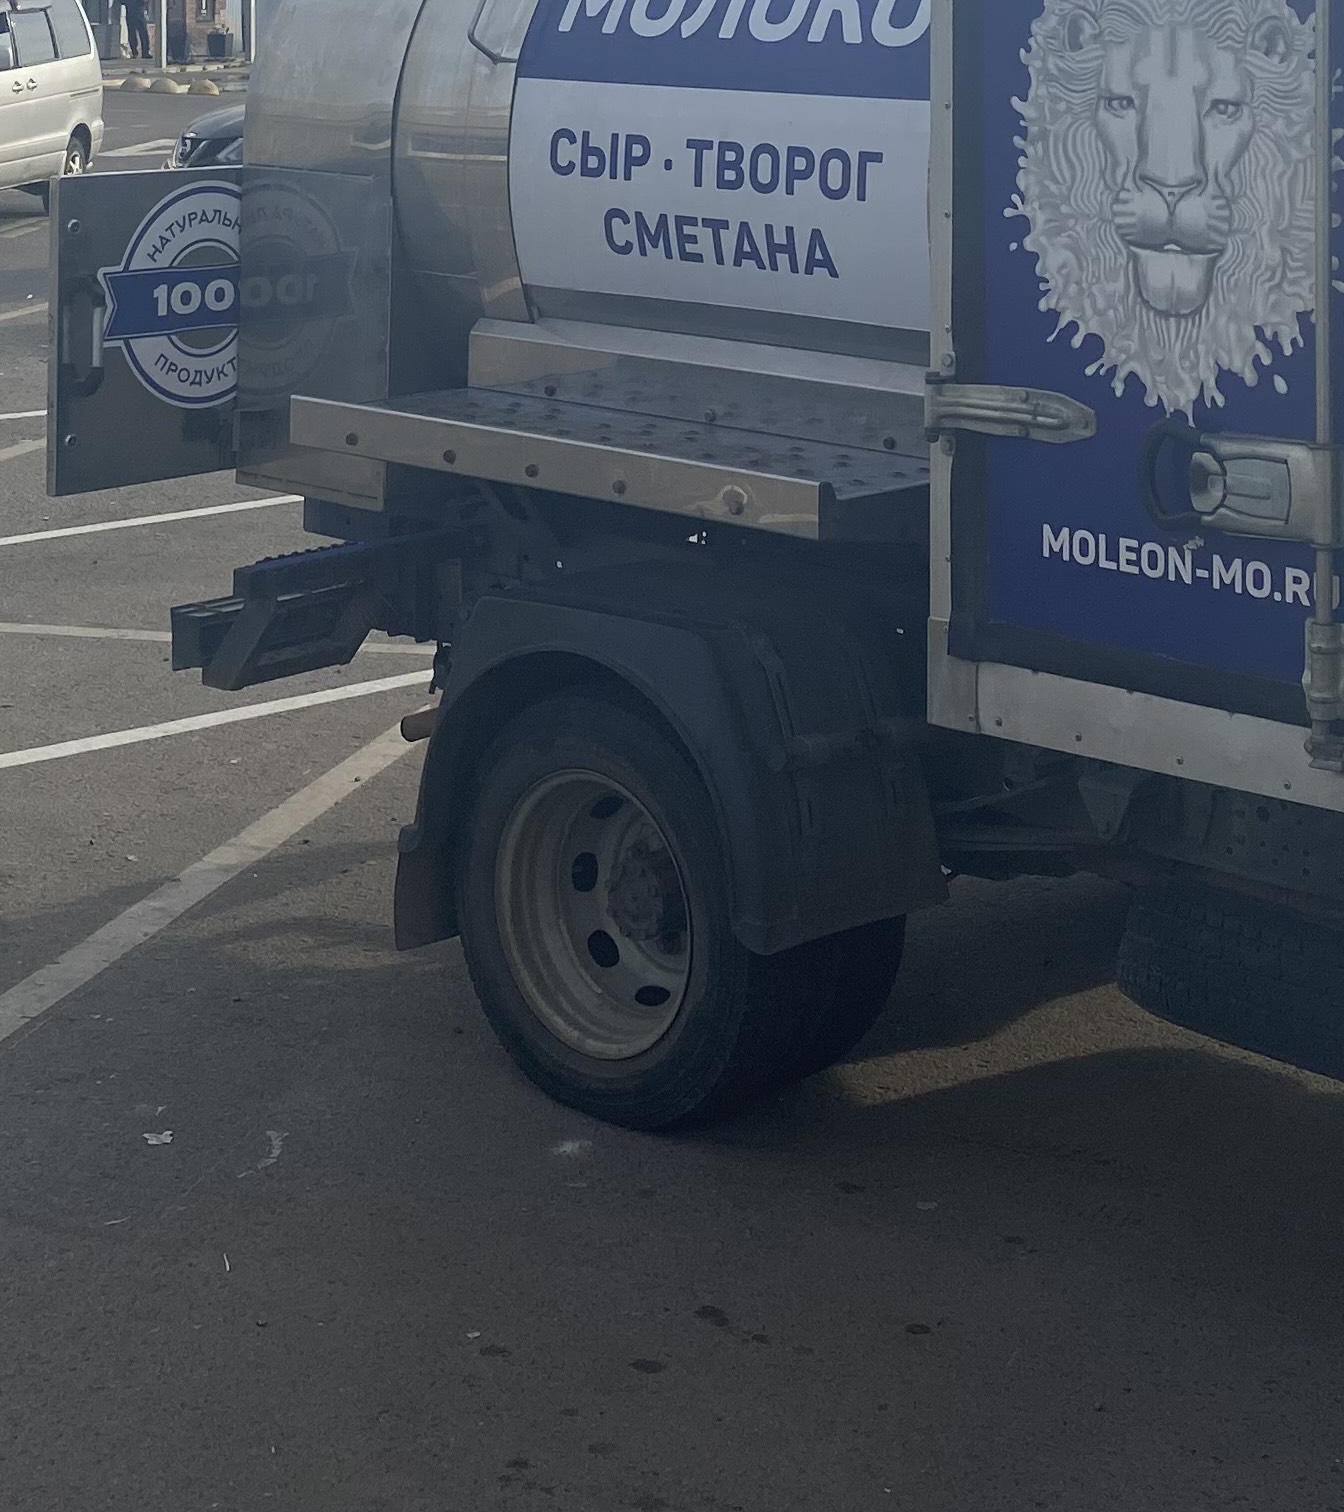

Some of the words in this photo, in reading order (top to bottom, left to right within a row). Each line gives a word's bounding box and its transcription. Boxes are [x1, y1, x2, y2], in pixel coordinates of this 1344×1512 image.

[549, 127, 652, 182] СЫР
[685, 137, 884, 202] ТВОРОГ
[146, 208, 242, 263] НАТУРАЛЬН
[603, 207, 840, 279] СМЕТАНА
[153, 278, 236, 317] 100
